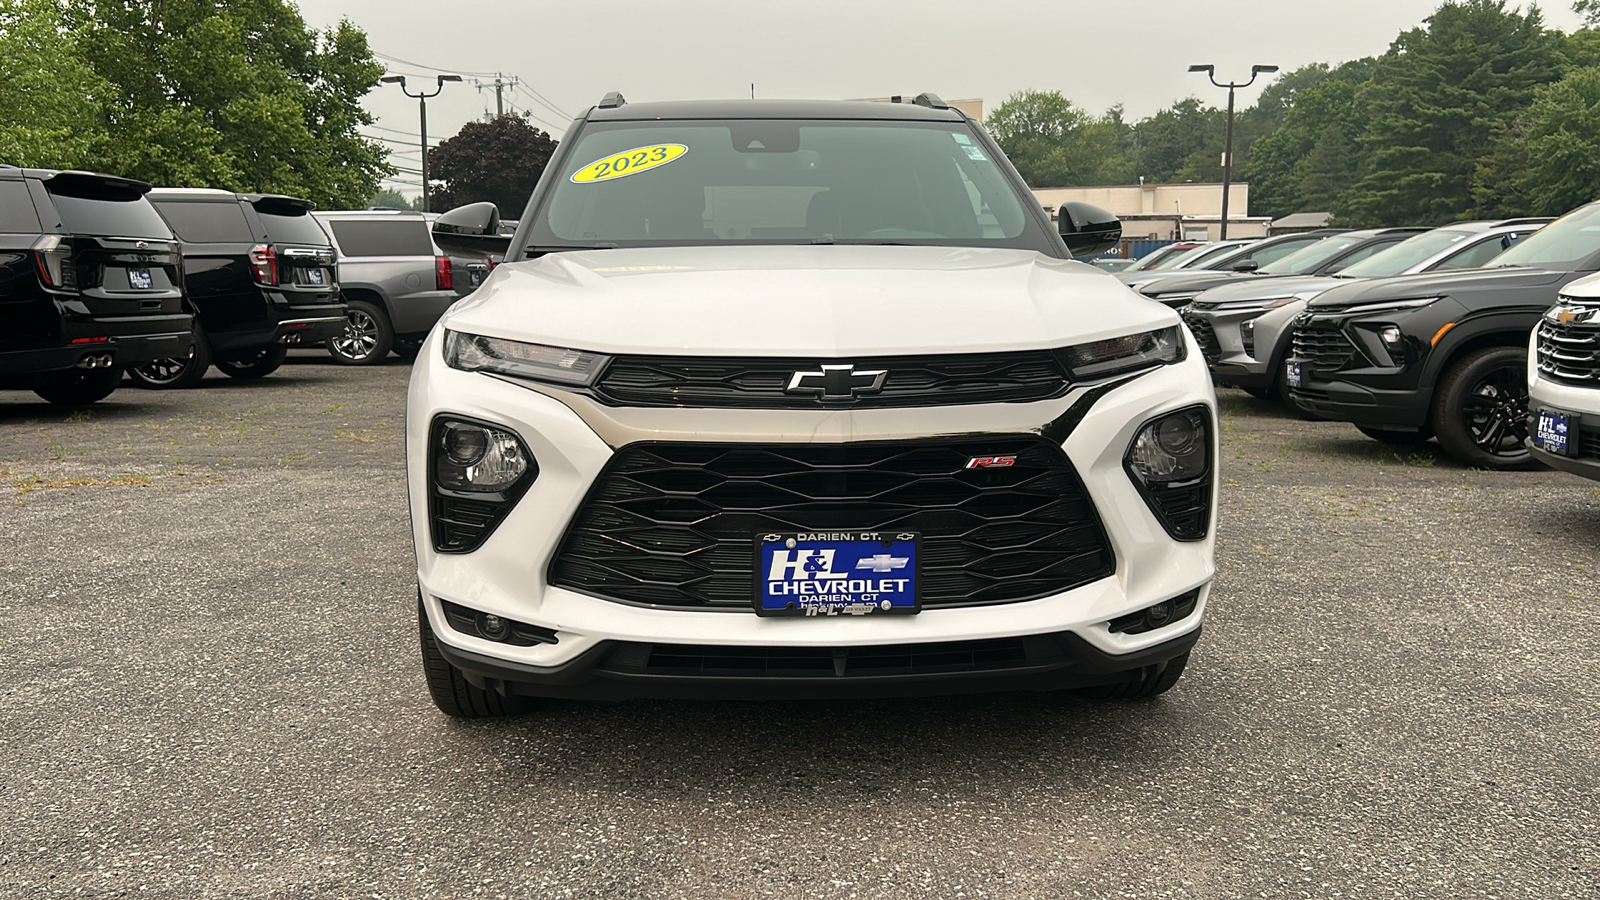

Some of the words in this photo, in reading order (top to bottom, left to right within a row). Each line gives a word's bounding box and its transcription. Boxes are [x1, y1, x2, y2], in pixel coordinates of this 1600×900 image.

[594, 147, 667, 179] 2023
[965, 455, 1017, 468] RS
[797, 533, 854, 541] DARIEN,
[860, 532, 881, 540] CT.
[768, 549, 849, 581] H&L
[768, 579, 910, 595] CHEVROLET
[799, 594, 856, 603] DARIEN,
[860, 593, 879, 601] CT
